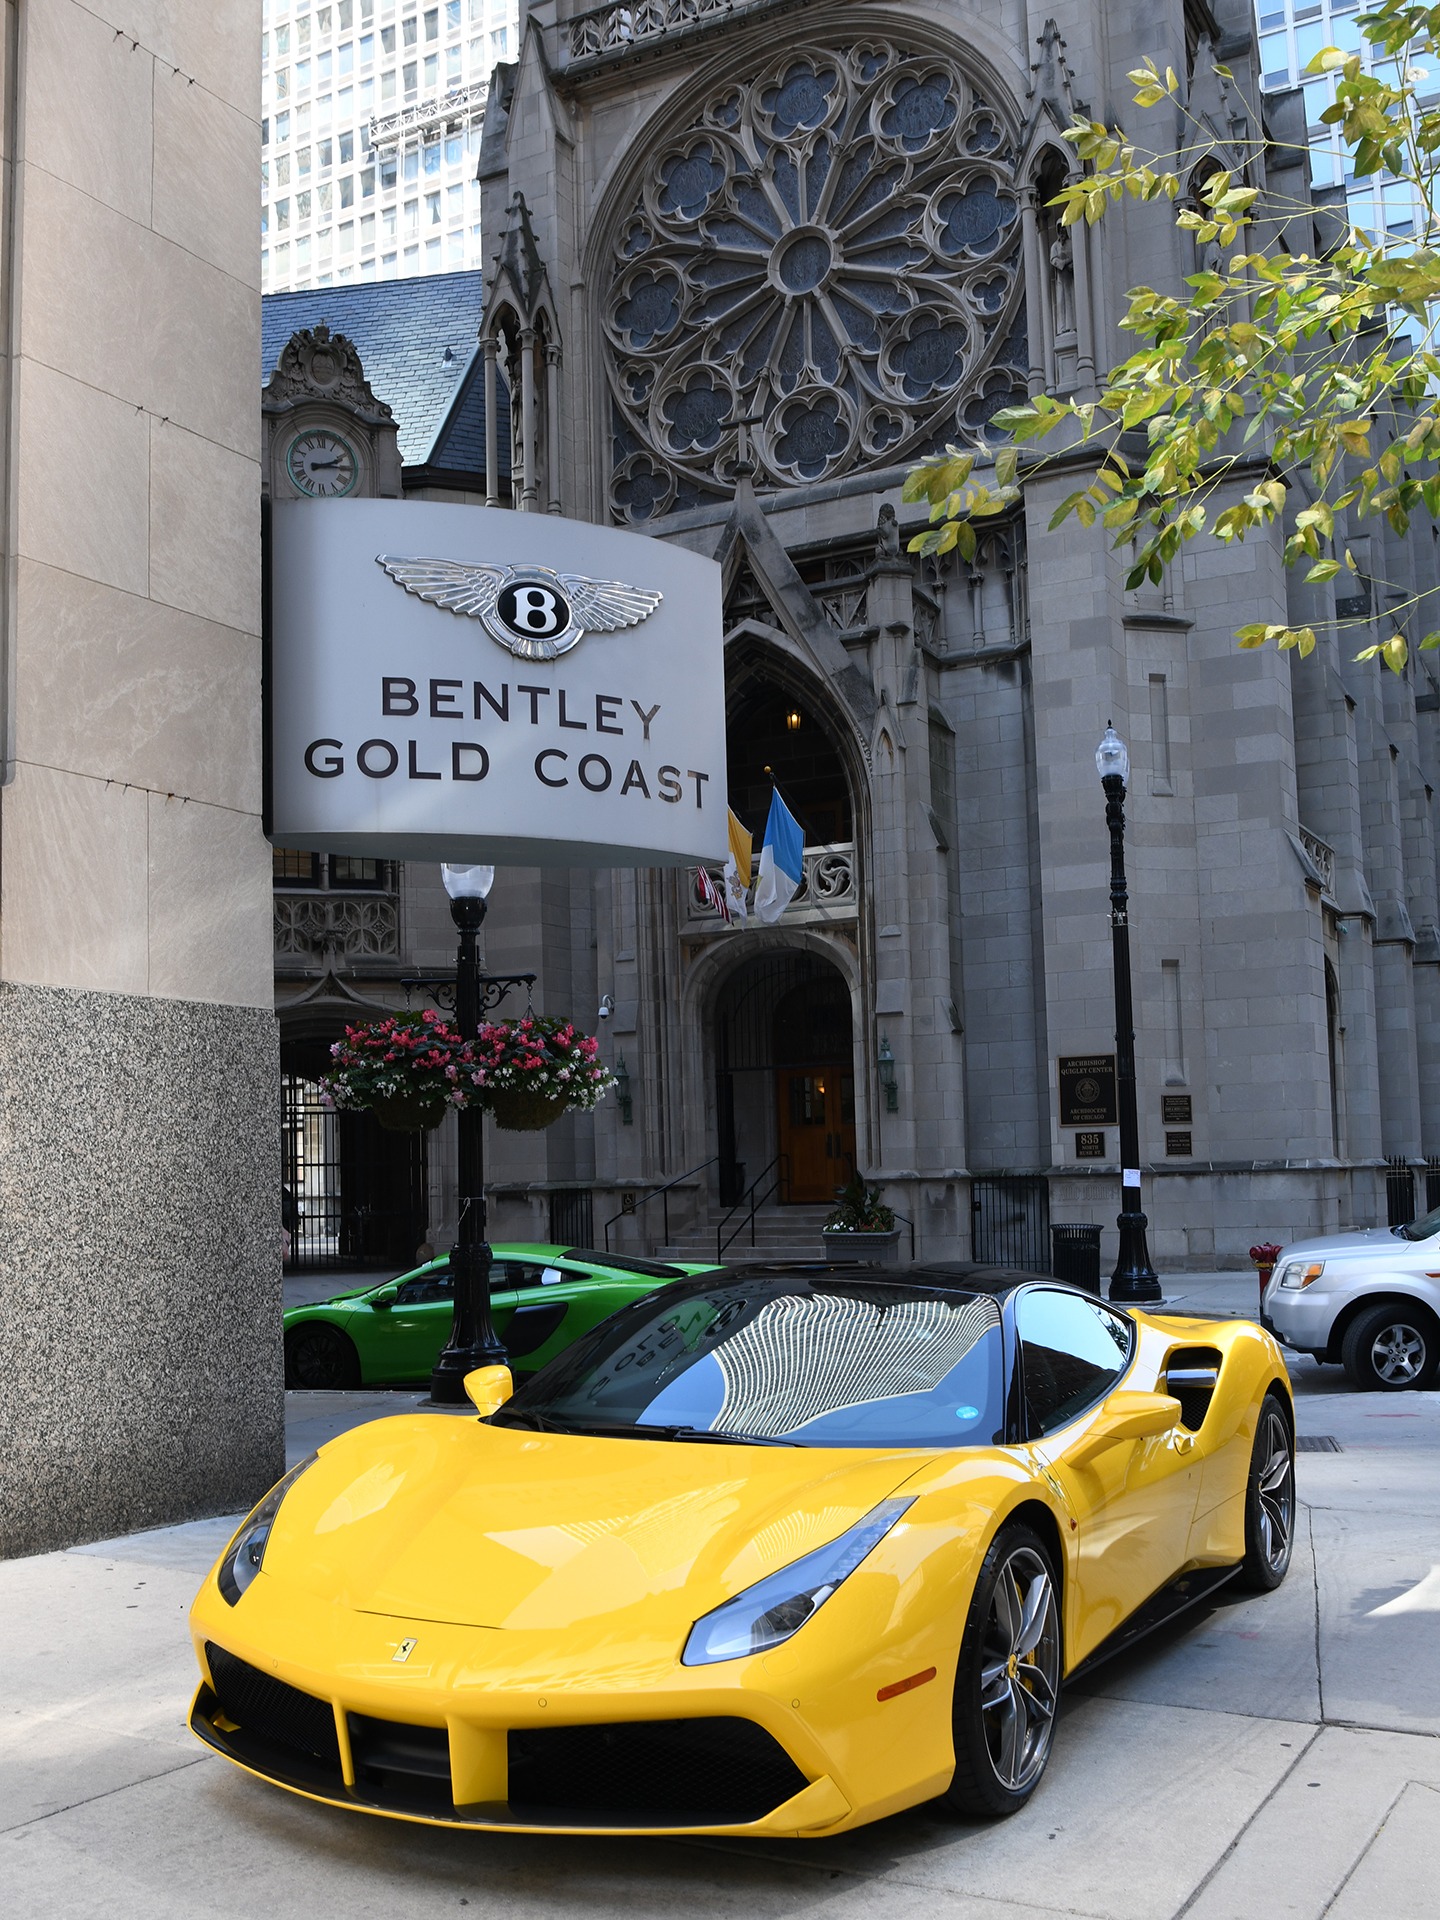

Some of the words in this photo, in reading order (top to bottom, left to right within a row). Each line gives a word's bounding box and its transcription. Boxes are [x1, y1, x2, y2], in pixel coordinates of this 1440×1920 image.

[381, 676, 661, 740] BENTLEY
[304, 738, 489, 782] GOLD
[534, 748, 709, 809] COAST
[1067, 1059, 1106, 1067] ARCHBISHOP
[1081, 1134, 1099, 1145] 835
